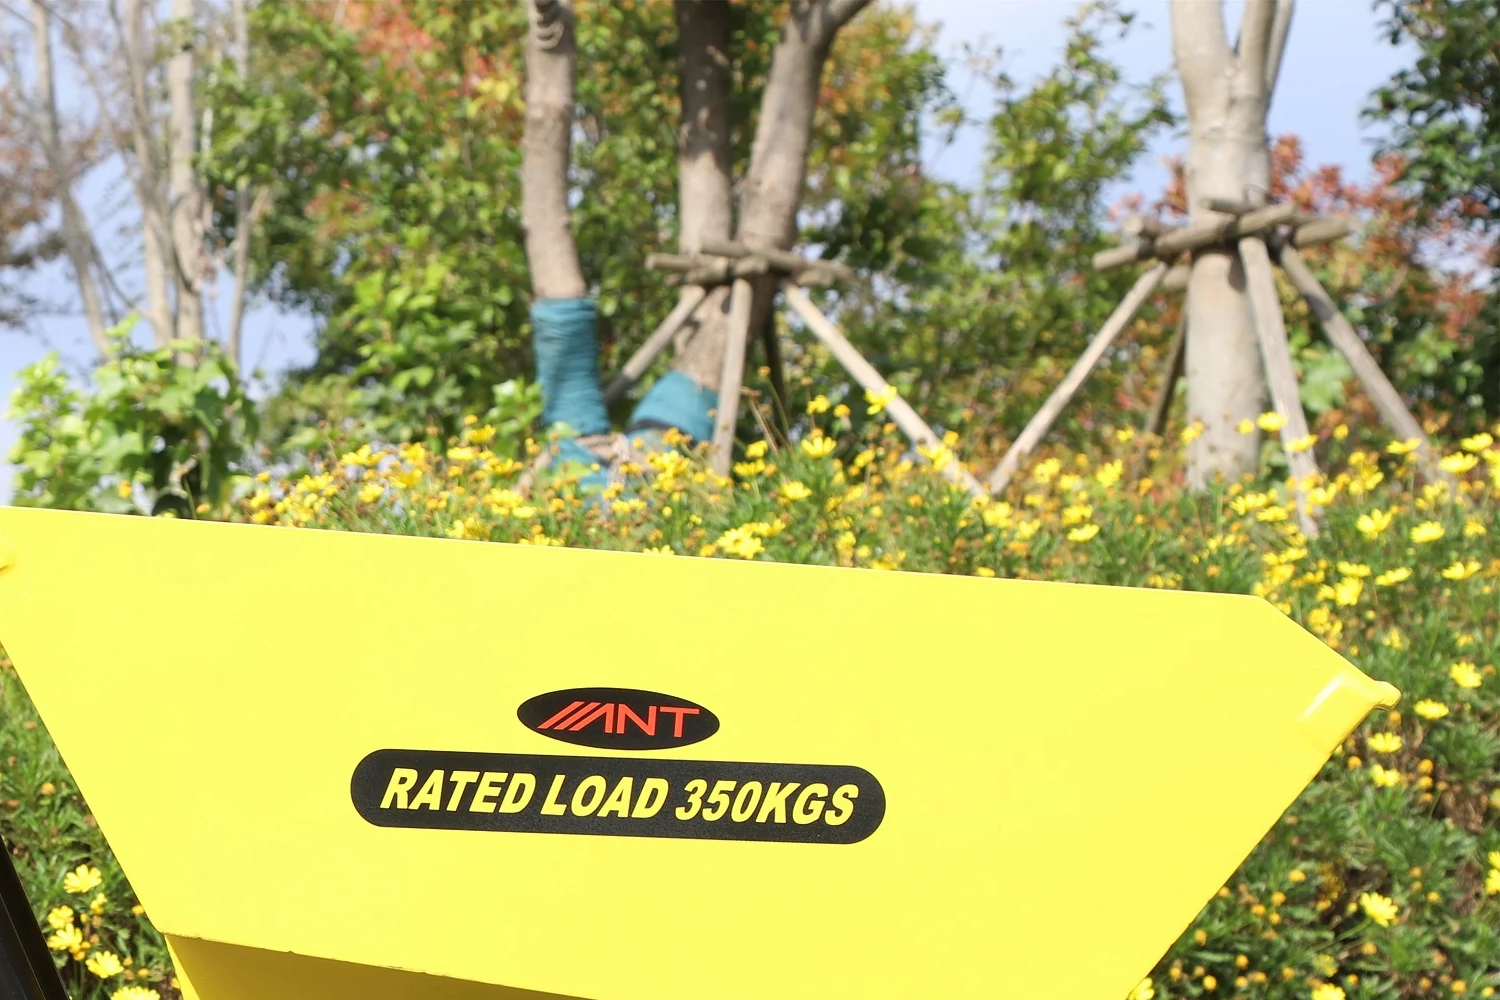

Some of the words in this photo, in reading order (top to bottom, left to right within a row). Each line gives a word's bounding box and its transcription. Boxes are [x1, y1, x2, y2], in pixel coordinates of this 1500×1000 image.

[380, 768, 536, 816] RATED
[541, 774, 669, 818] LOAD
[676, 779, 859, 826] 350KGS
